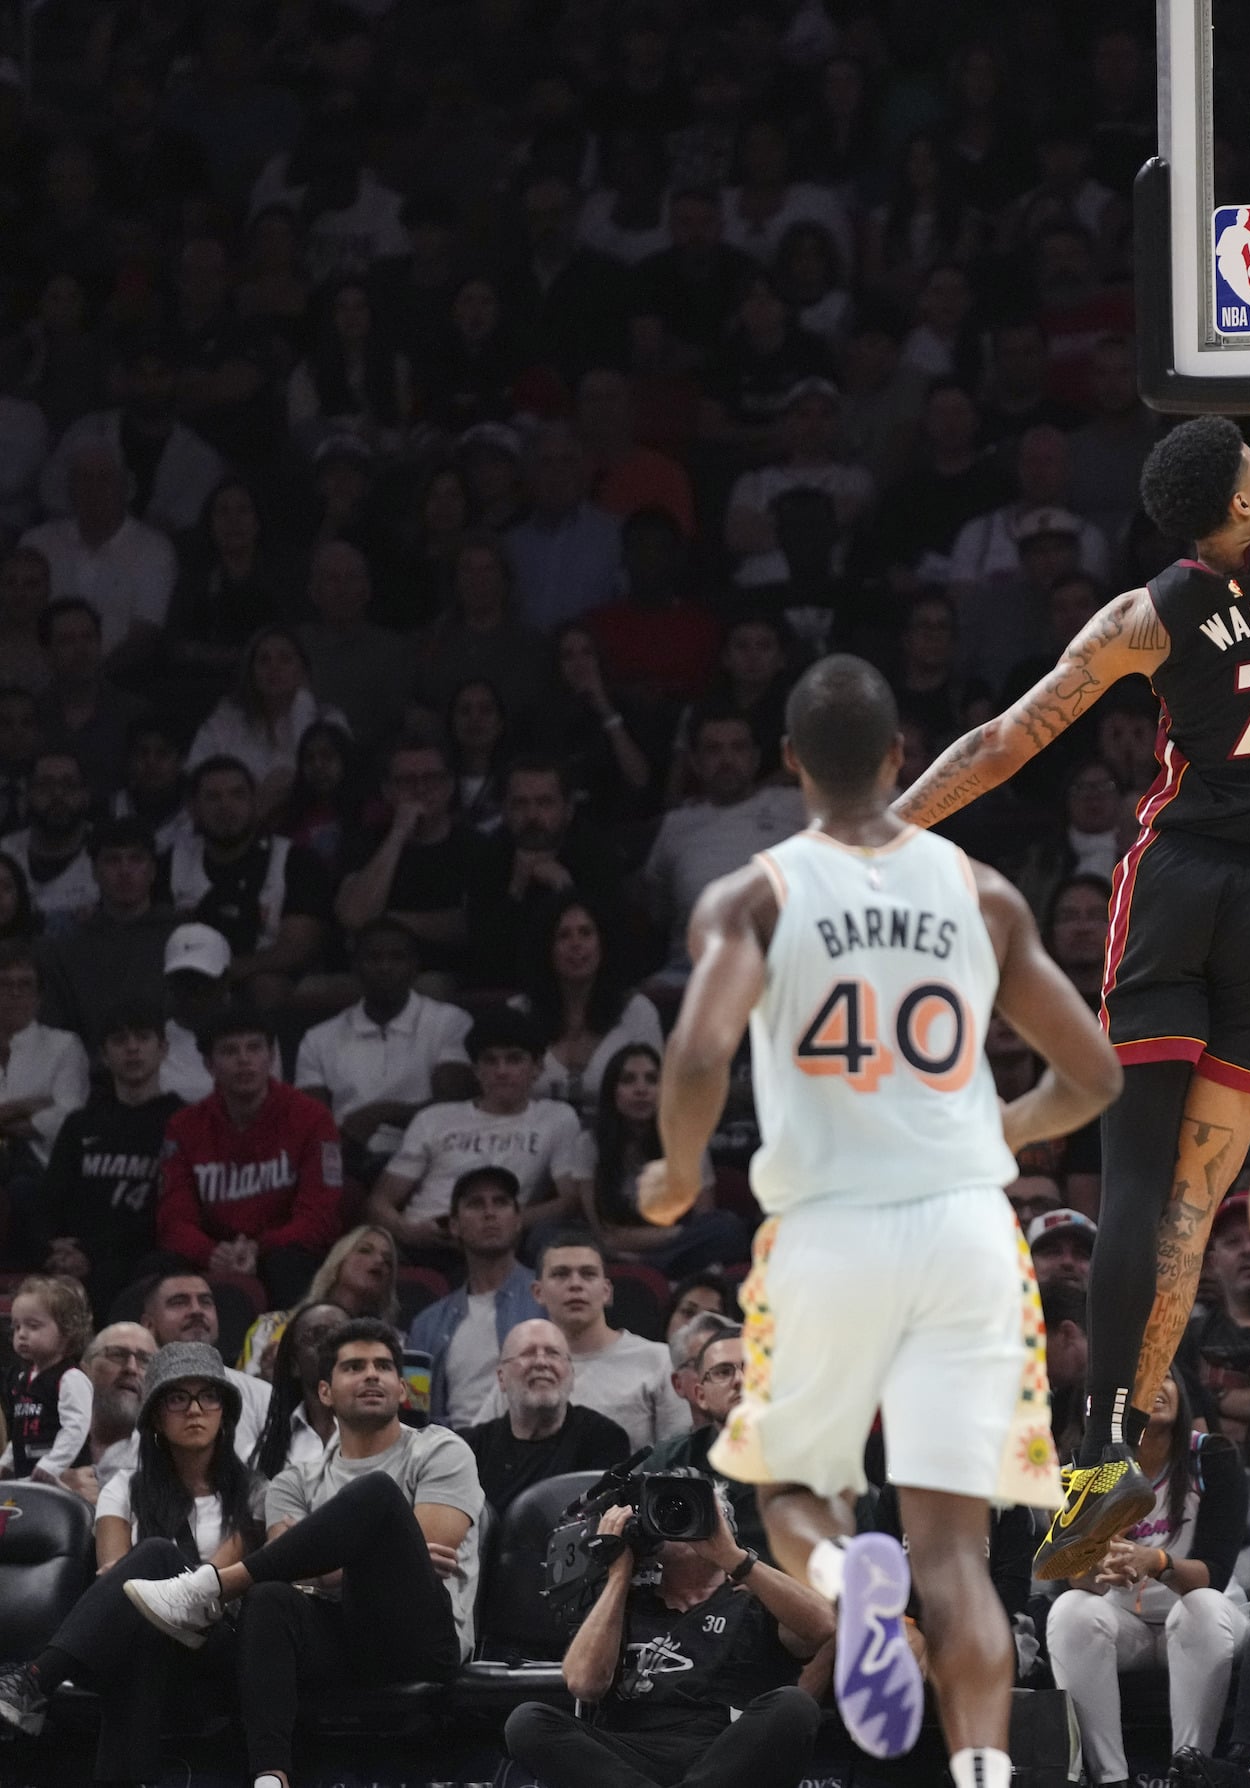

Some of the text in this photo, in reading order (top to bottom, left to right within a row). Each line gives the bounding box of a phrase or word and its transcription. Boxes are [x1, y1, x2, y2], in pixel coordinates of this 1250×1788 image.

[1221, 306, 1249, 328] NBA
[816, 906, 957, 960] BARNES
[792, 974, 977, 1093] 40
[81, 1153, 158, 1178] MIAMI
[702, 1615, 727, 1634] 30
